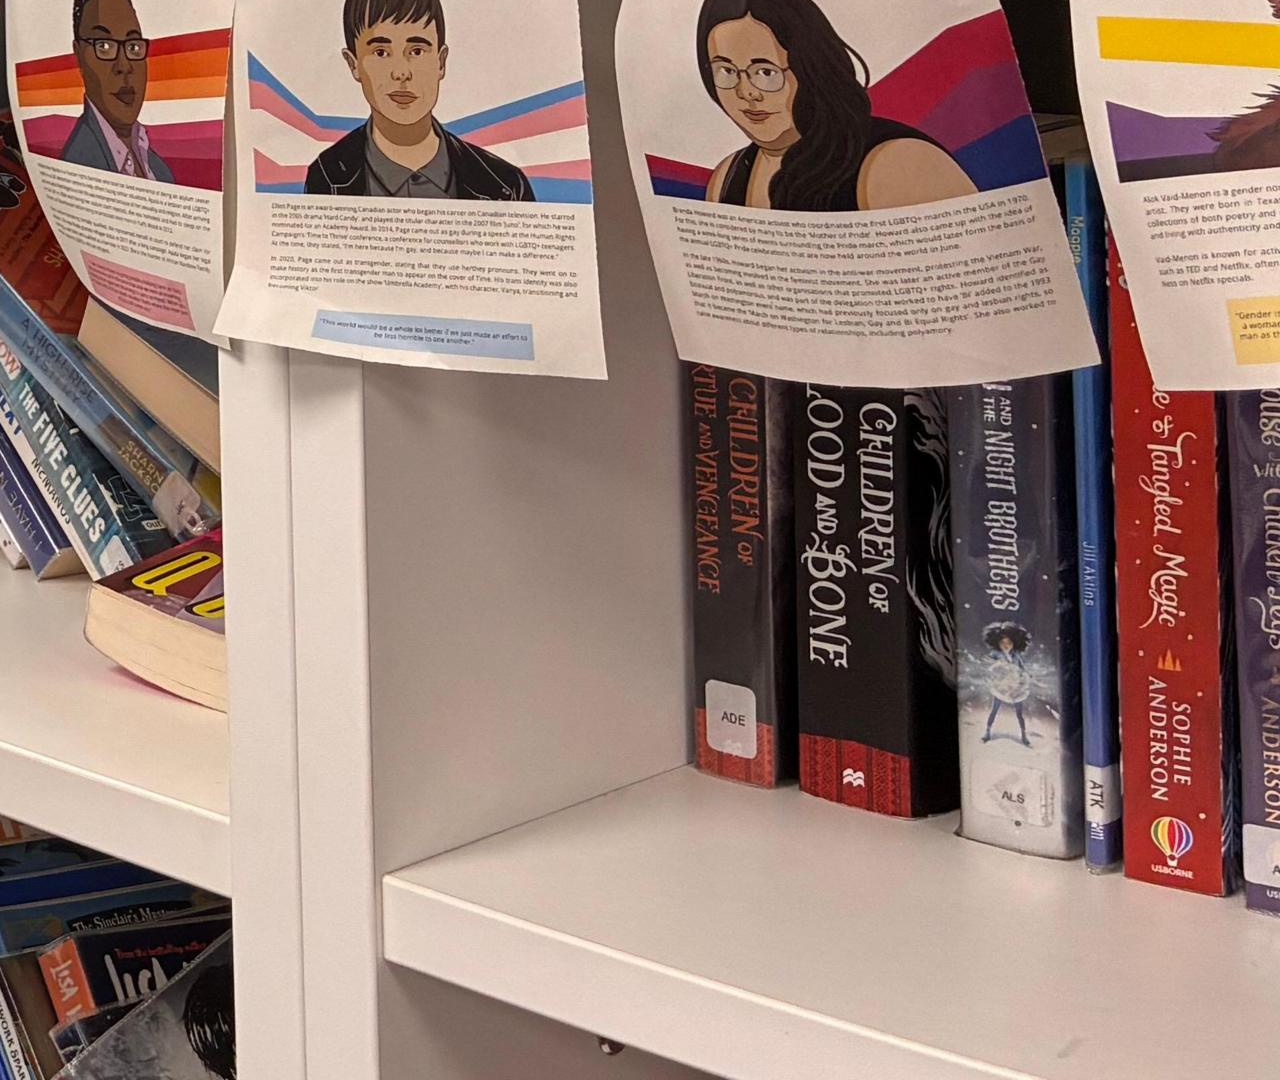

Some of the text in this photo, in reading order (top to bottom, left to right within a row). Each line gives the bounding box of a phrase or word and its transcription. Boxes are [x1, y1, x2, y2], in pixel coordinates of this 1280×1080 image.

[1160, 184, 1263, 203] Vaid-Menon gender
[1169, 199, 1241, 214] They were born
[1201, 209, 1276, 222] both poetry and
[1207, 223, 1260, 235] authenticity
[1203, 264, 1219, 273] and
[1210, 248, 1257, 259] known for
[1240, 331, 1271, 340] man as
[31, 324, 97, 404] HIGH-RISE
[999, 396, 1012, 425] AND
[18, 381, 105, 544] THE FIVE CLUES
[727, 376, 764, 566] CHILDREN OF
[7, 491, 36, 538] HAVE
[856, 402, 901, 613] CHILDREN OF
[983, 395, 1020, 612] THE NIGHT BROTHERS
[694, 447, 721, 595] VENGEANCE
[1139, 431, 1197, 630] Tangled Magic
[800, 492, 857, 668] AND BONE
[721, 709, 747, 728] ADE
[1148, 675, 1170, 801] ANDERSON
[1171, 700, 1192, 787] SOPHIE
[1001, 790, 1025, 805] ALS
[1089, 779, 1105, 809] ATK
[1151, 863, 1195, 880] USBORNE
